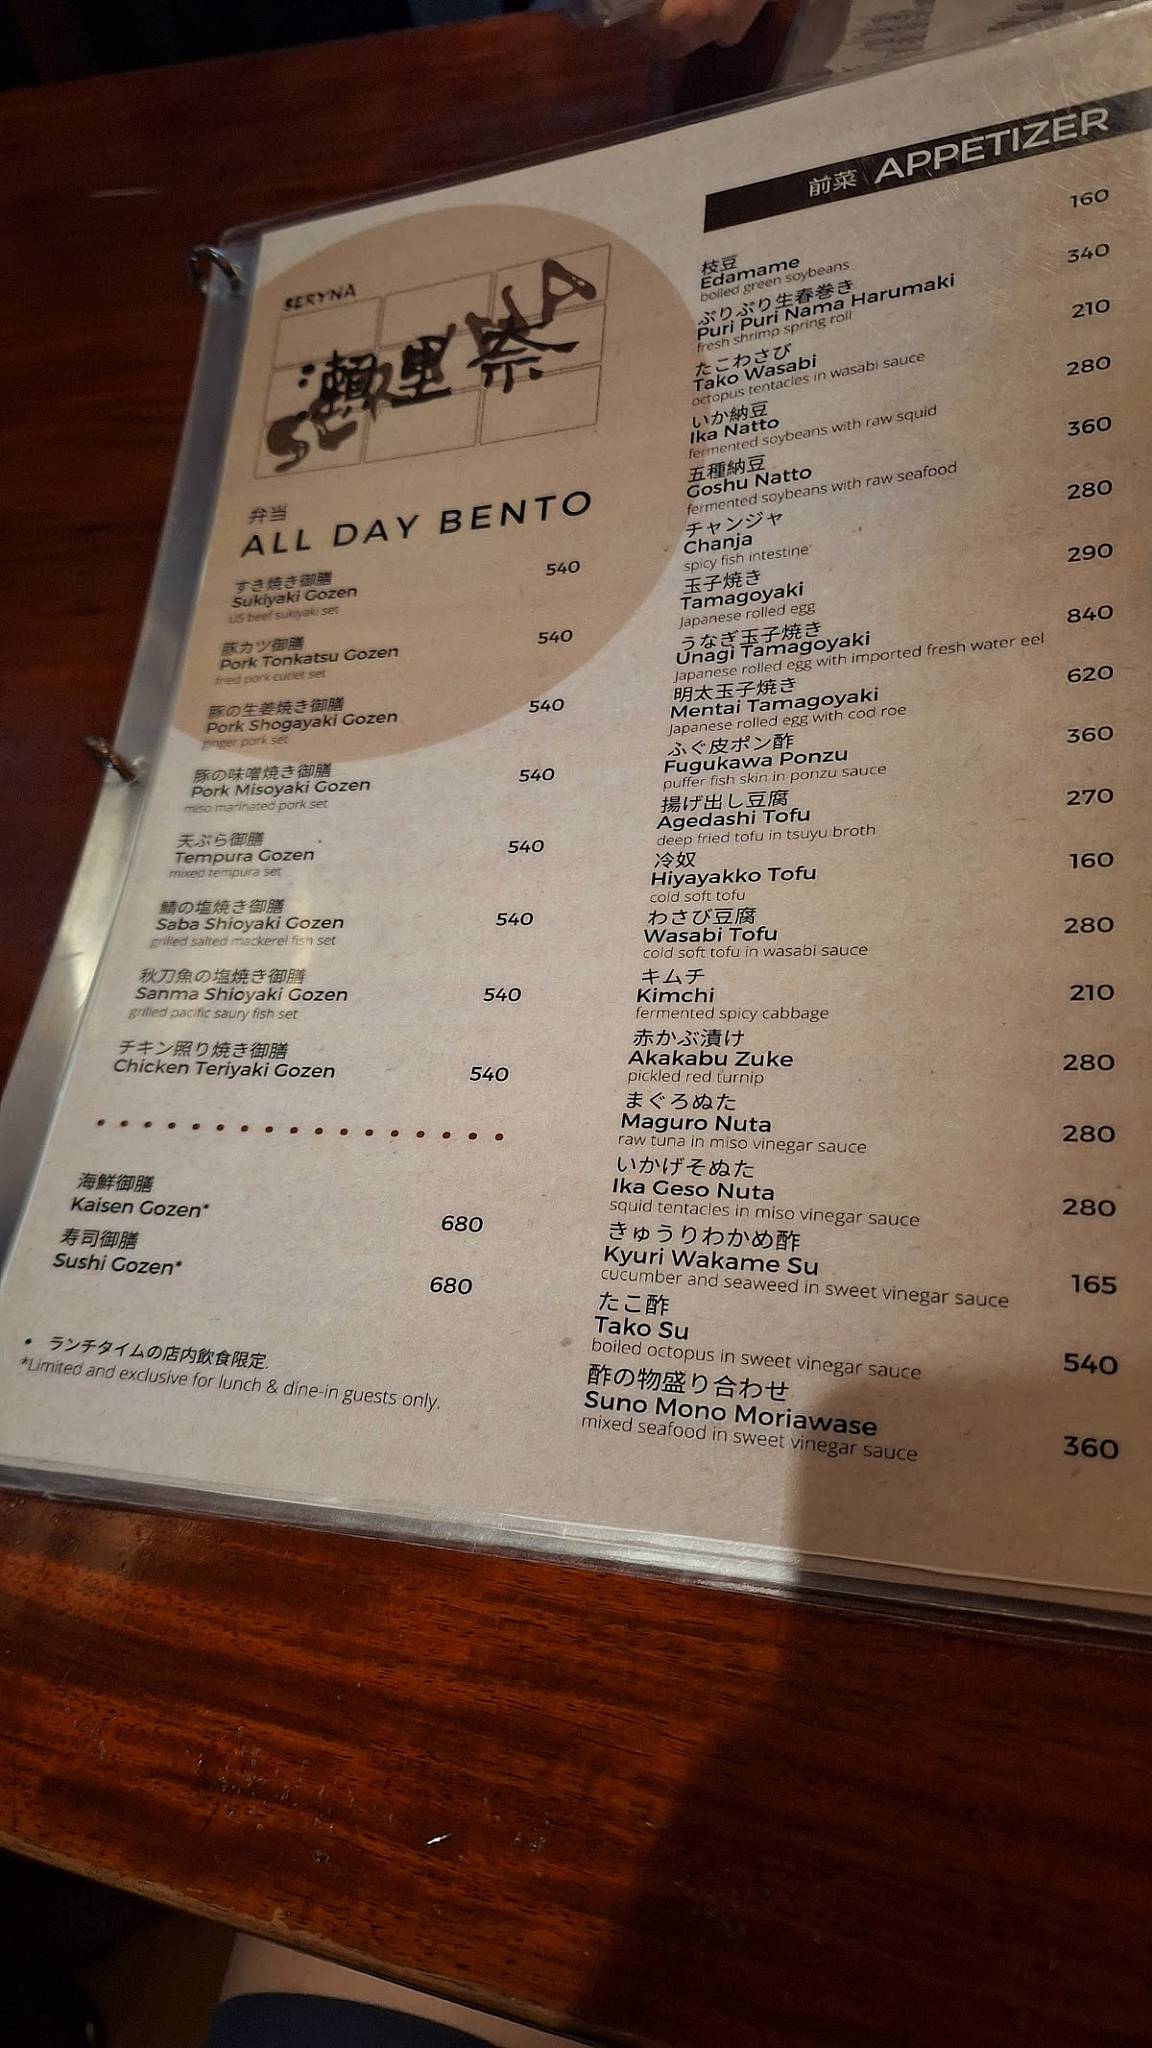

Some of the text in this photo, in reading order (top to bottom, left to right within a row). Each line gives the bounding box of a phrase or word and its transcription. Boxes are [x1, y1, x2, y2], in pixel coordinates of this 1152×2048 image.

[808, 107, 1110, 198] 前菜 APPETIZER
[1069, 188, 1110, 209] 160
[1067, 243, 1110, 264] 340
[700, 253, 738, 276] 枝豆
[700, 257, 800, 290] Edamame
[283, 283, 357, 312] SERYNA
[696, 272, 954, 341] Puri Puri Nama Harumaki
[1071, 298, 1111, 319] 210
[696, 309, 852, 353] fresh shrimp spring roll
[692, 353, 816, 392] Tako Wasabi
[1066, 355, 1112, 377] 280
[691, 399, 768, 429] いか納豆
[689, 418, 779, 444] Ika Natto
[1067, 416, 1112, 437] 360
[685, 467, 812, 498] Goshu Natto
[1066, 479, 1113, 501] 280
[240, 491, 591, 557] ALL DAY BENTO
[683, 531, 752, 554] Chanja
[1067, 542, 1114, 563] 290
[545, 560, 581, 577] 540
[683, 544, 812, 574] spicy fish intestine
[682, 569, 761, 595] 玉子焼き
[230, 586, 358, 608] Sukiyaki Gozen
[679, 580, 804, 610] Tamagoyaki
[677, 602, 816, 630] Japanese rolled egg
[1066, 604, 1114, 624] 840
[537, 629, 574, 645] 540
[675, 629, 870, 665] Unagi Tamagoyaki
[219, 646, 399, 670] Pork Tonkatsu Gozen
[1067, 665, 1114, 683] 620
[528, 698, 565, 714] 540
[669, 686, 879, 719] Mentai Tamagoyaki
[205, 712, 398, 733] Pork Shogayaki Gozen
[1066, 725, 1114, 744] 360
[663, 749, 848, 775] Fugukawa Ponzu
[518, 767, 555, 783] 540
[190, 779, 371, 798] Pork Misoyaki Gozen
[1066, 788, 1114, 806] 270
[660, 788, 789, 813] 揚げ出し豆腐
[655, 807, 810, 832] Agedashi Tofu
[174, 848, 315, 865] Tempura Gozen
[507, 839, 545, 854] 540
[653, 850, 696, 868] 冷奴
[1069, 851, 1114, 869] 160
[650, 864, 816, 889] Hiyayakko Tofu
[649, 888, 745, 903] cold soft tofu
[154, 915, 344, 933] Saba Shioyaki Gozen
[495, 912, 534, 927] 540
[647, 905, 756, 926] わさび豆腐
[1063, 916, 1115, 934] 280
[643, 925, 777, 943] Wasabi Tofu
[641, 967, 705, 985] キムチ
[134, 985, 348, 1004] Sanma Shioyaki Gozen
[482, 987, 522, 1002] 540
[636, 986, 714, 1003] Kimchi
[1069, 984, 1115, 1002] 210
[635, 1005, 829, 1023] fermented spicy cabbage
[632, 1027, 745, 1047] 赤かぶ漬け
[627, 1048, 793, 1067] Akakabu Zuke
[1063, 1053, 1115, 1071] 280
[113, 1058, 335, 1079] Chicken Teriyaki Gozen
[469, 1066, 509, 1082] 540
[627, 1068, 764, 1087] pickled red turnip
[625, 1090, 736, 1111] まぐろぬた
[620, 1112, 771, 1133] Maguro Nuta
[1062, 1124, 1116, 1144] 280
[612, 1176, 774, 1200] Ika Geso Nuta
[69, 1196, 134, 1214] Kaisen
[1062, 1197, 1117, 1217] 280
[441, 1215, 484, 1233] 680
[51, 1252, 106, 1271] Sushi
[603, 1245, 818, 1276] Kyuri Wakame Su
[429, 1276, 473, 1295] 680
[1071, 1273, 1118, 1295] 165
[598, 1291, 669, 1316] たこ酢
[593, 1315, 688, 1340] Tako Su
[1063, 1352, 1119, 1376] 540
[84, 1365, 116, 1379] and
[118, 1367, 188, 1386] exclusive
[191, 1371, 215, 1388] for
[217, 1373, 261, 1392] lunch
[265, 1378, 278, 1394] &
[282, 1379, 339, 1399] dine-in
[340, 1388, 397, 1405] guests
[401, 1392, 440, 1413] only.
[586, 1362, 789, 1402] 酢の物盛り合わせ
[583, 1389, 877, 1436] Suno Mono Moriawase
[580, 1416, 918, 1462] mixed seafood in sweet vinegar sauce
[1063, 1435, 1120, 1460] 360
